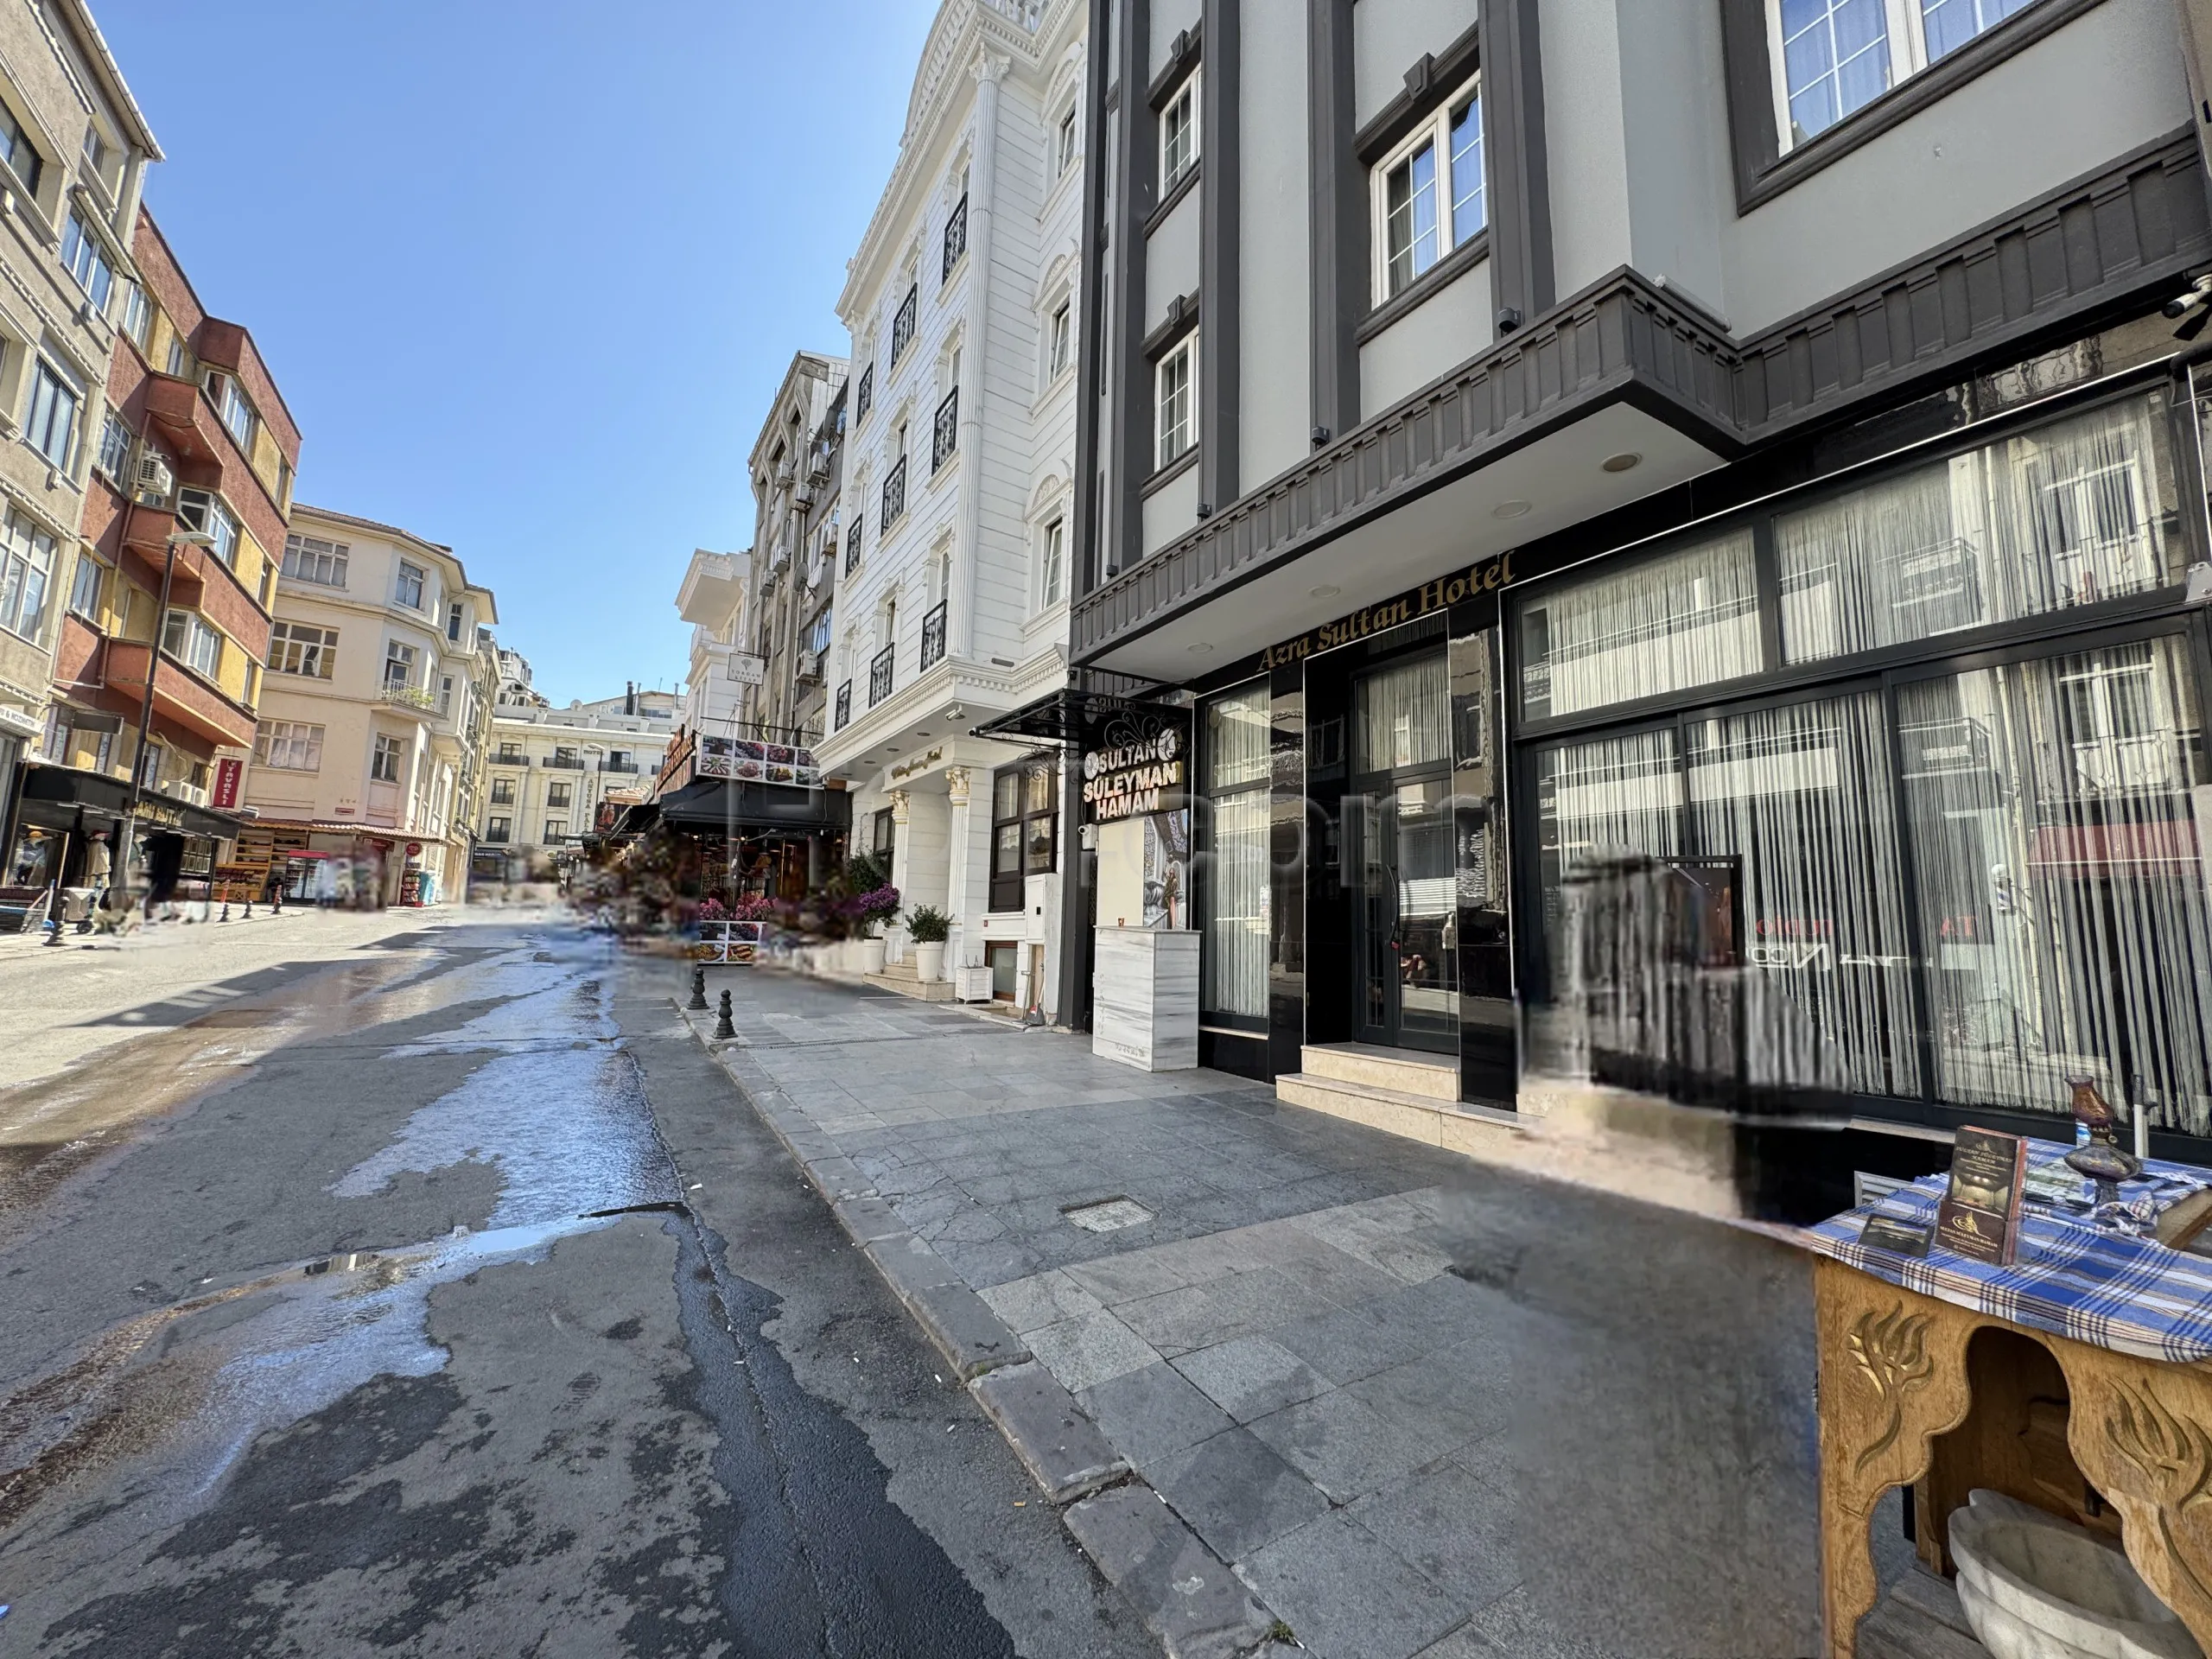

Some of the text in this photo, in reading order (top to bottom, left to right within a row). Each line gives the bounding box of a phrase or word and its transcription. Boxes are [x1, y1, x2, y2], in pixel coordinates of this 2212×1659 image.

[1256, 550, 1516, 672] Azra Sultan Hotel
[1098, 738, 1157, 773] SULTAN
[1084, 762, 1177, 803] SÜLEYMAN
[1096, 788, 1159, 820] HAMAM
